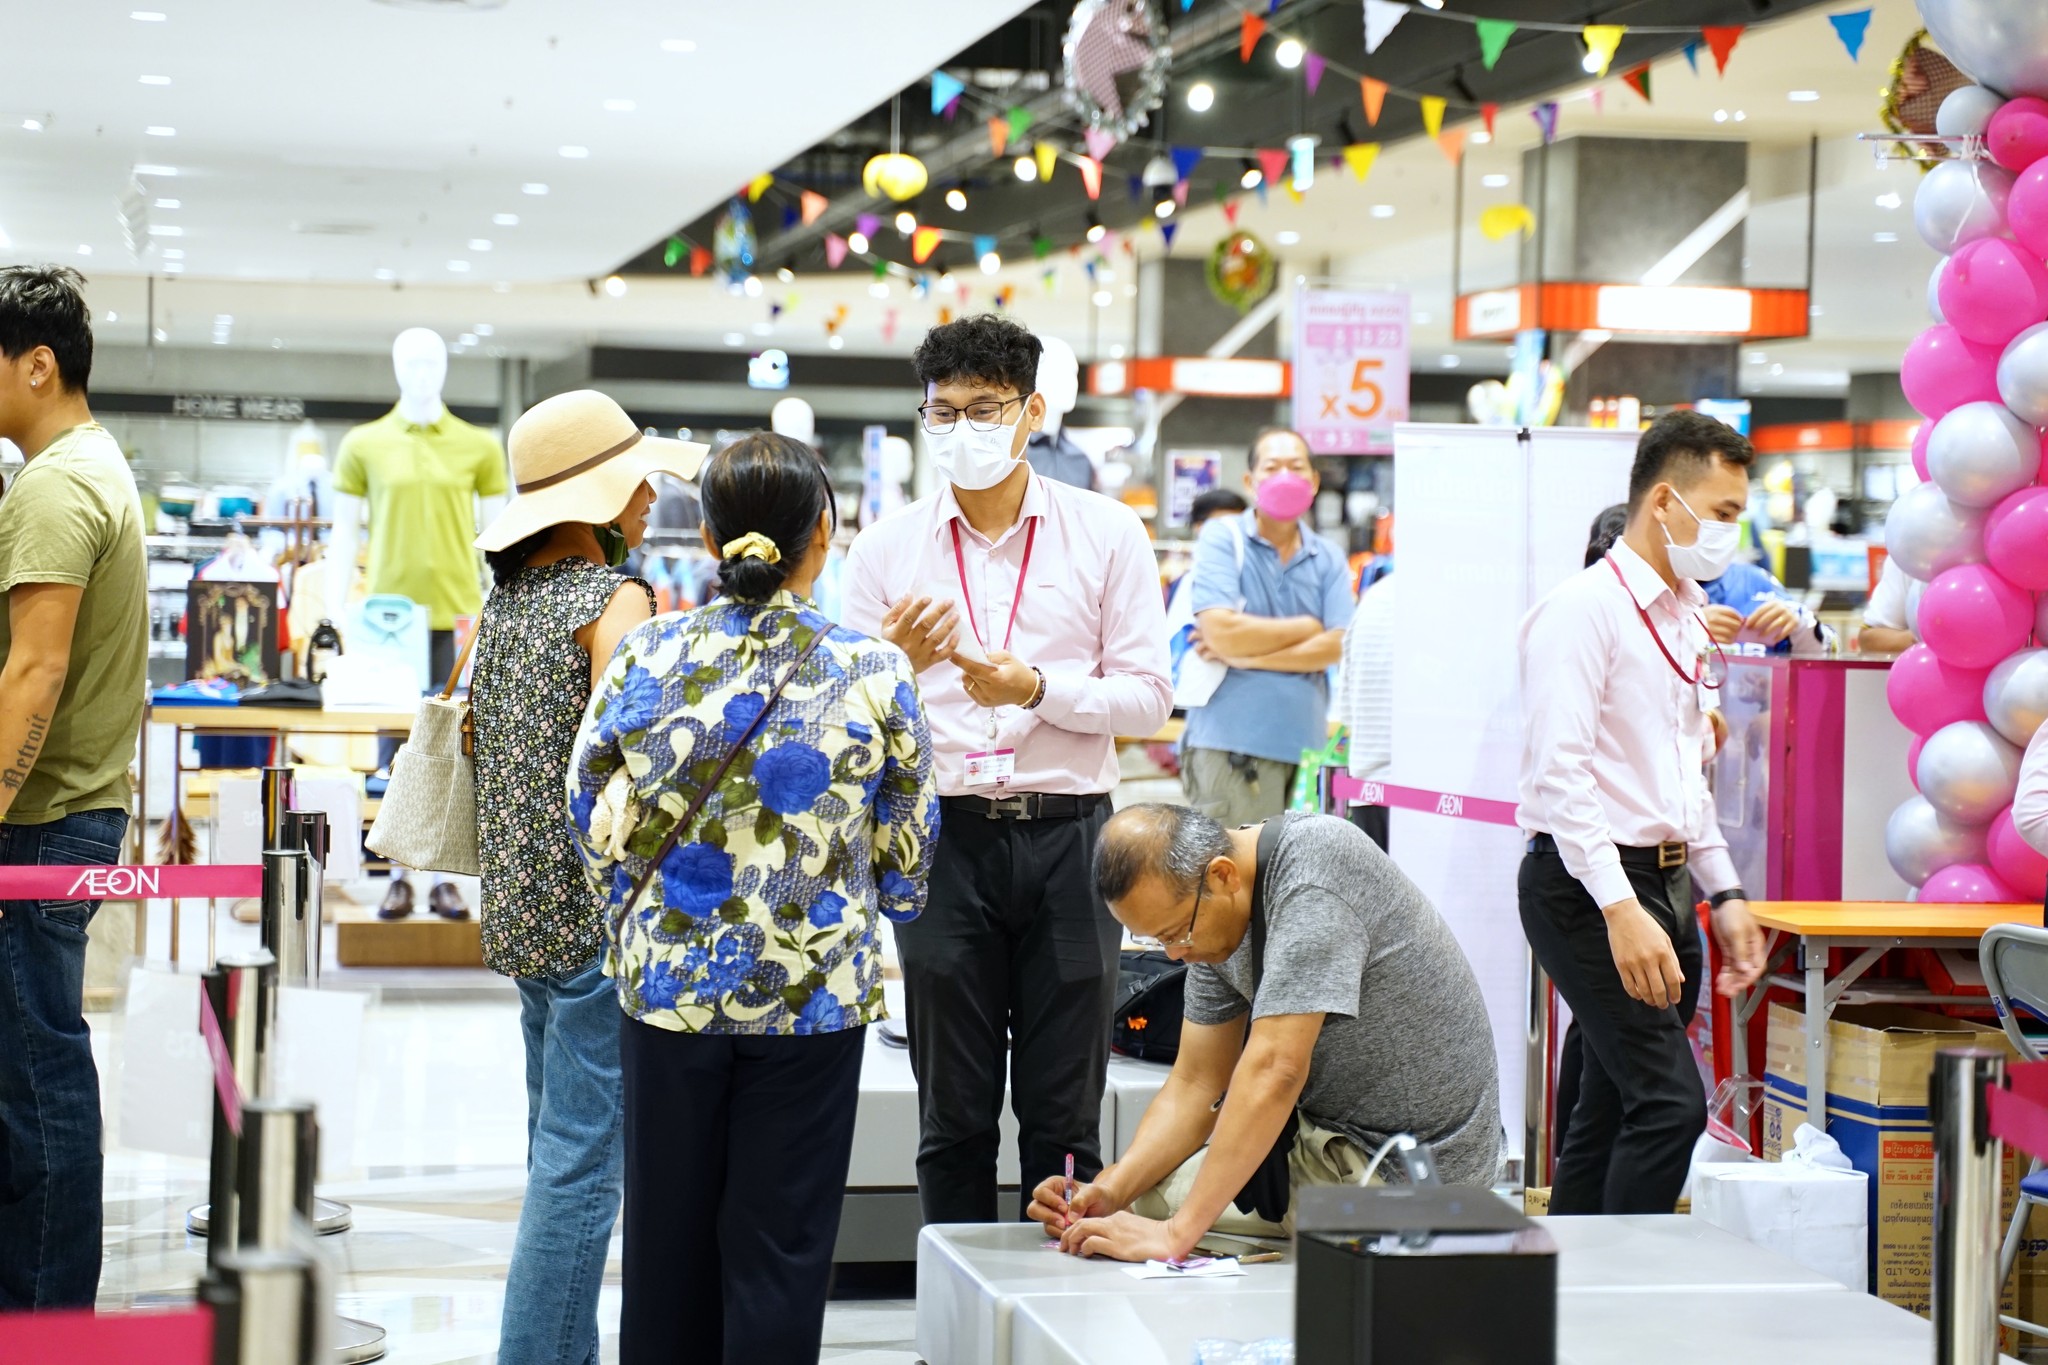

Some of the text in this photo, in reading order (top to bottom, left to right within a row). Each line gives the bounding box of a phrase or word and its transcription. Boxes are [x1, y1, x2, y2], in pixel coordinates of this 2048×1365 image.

[173, 394, 305, 420] HOME WEAR
[0, 713, 49, 790] Detroit
